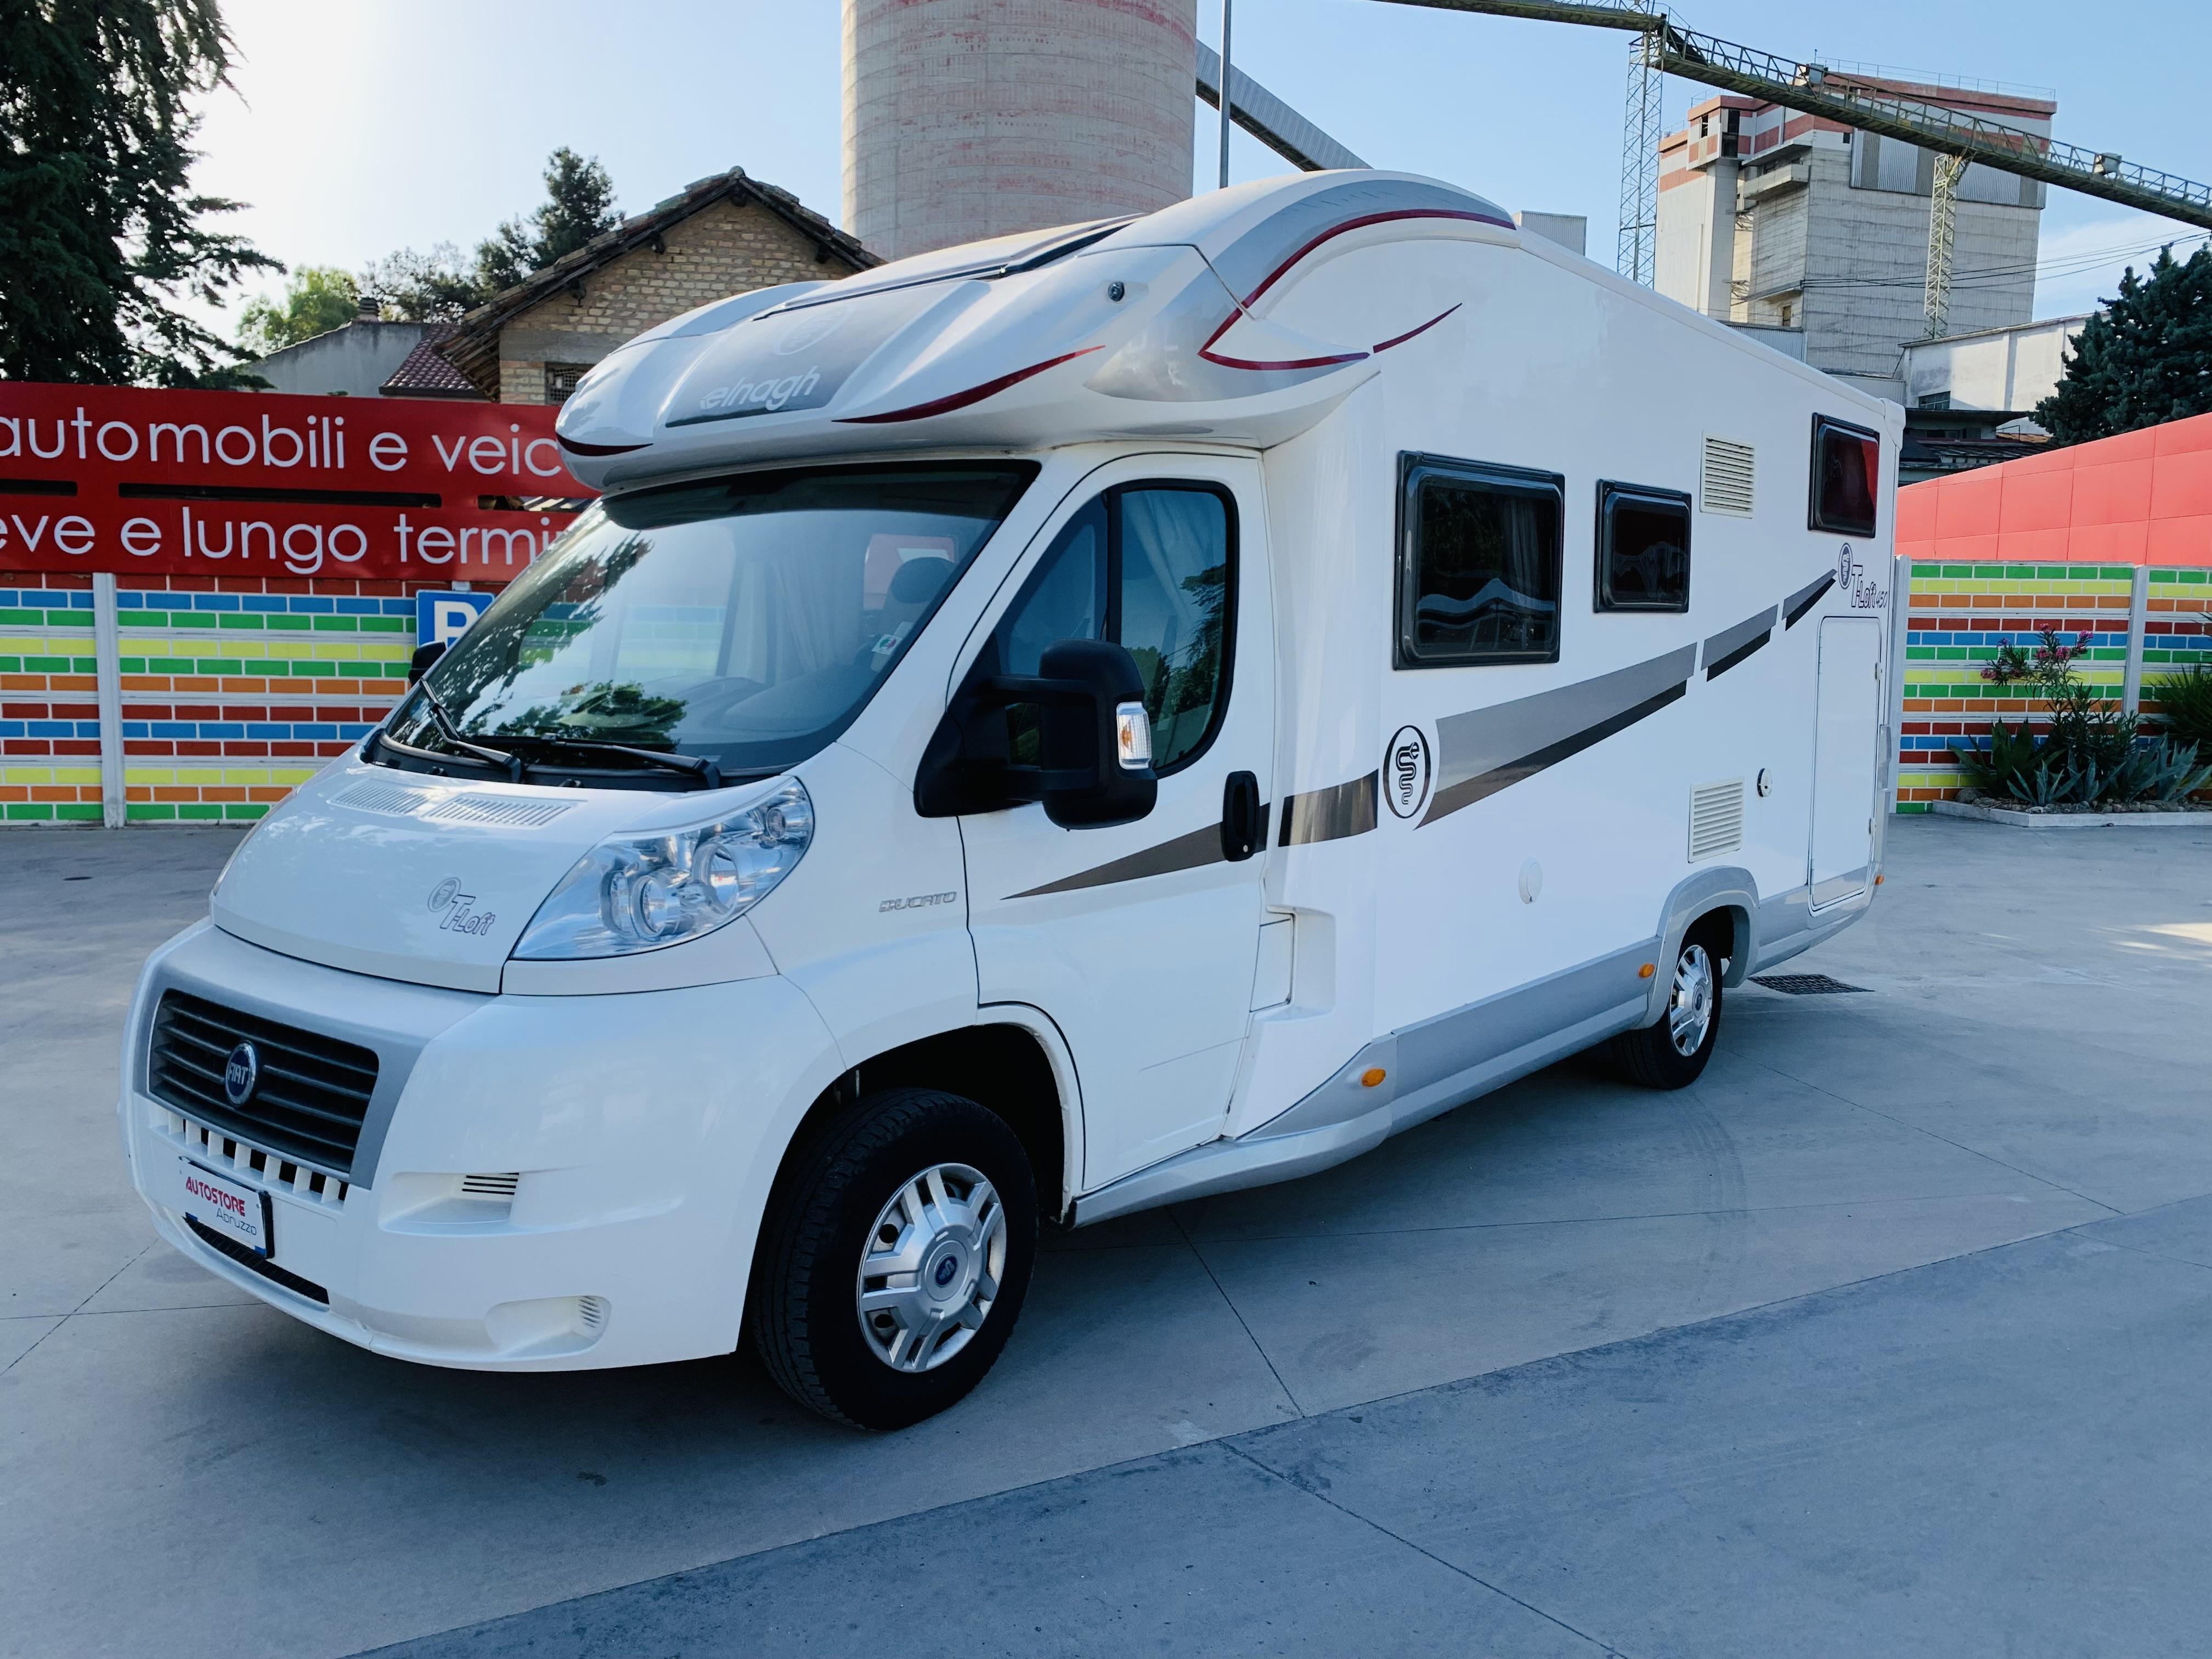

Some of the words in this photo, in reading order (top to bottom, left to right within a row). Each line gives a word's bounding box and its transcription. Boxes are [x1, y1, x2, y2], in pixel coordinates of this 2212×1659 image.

[699, 365, 820, 411] elnagh
[369, 432, 408, 472] e
[0, 515, 95, 555] ve
[121, 517, 162, 556] e
[182, 506, 368, 574] lungo
[393, 514, 565, 566] termi
[434, 601, 479, 653] P
[878, 891, 957, 912] DUCATO
[227, 1062, 249, 1085] FIAT
[185, 1176, 245, 1217] AUTOSTORE
[216, 1207, 257, 1235] Abruzzo
